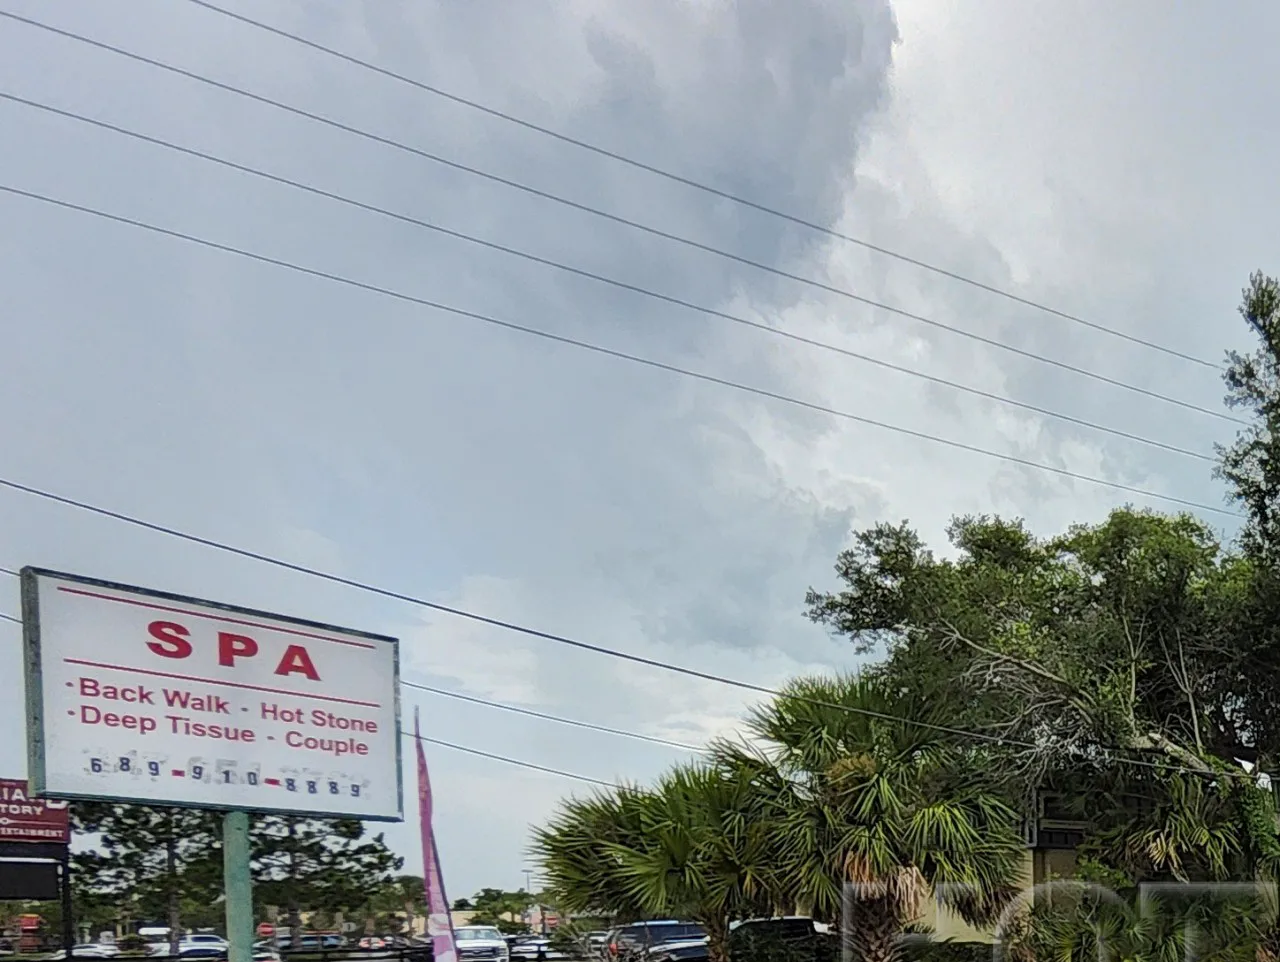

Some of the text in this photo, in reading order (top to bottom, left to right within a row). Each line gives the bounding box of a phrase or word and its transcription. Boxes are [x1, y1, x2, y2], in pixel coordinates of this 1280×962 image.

[145, 620, 322, 681] SPA
[79, 677, 378, 733] Back Walk Hot Stone
[80, 705, 369, 756] Deep Tissue Couple
